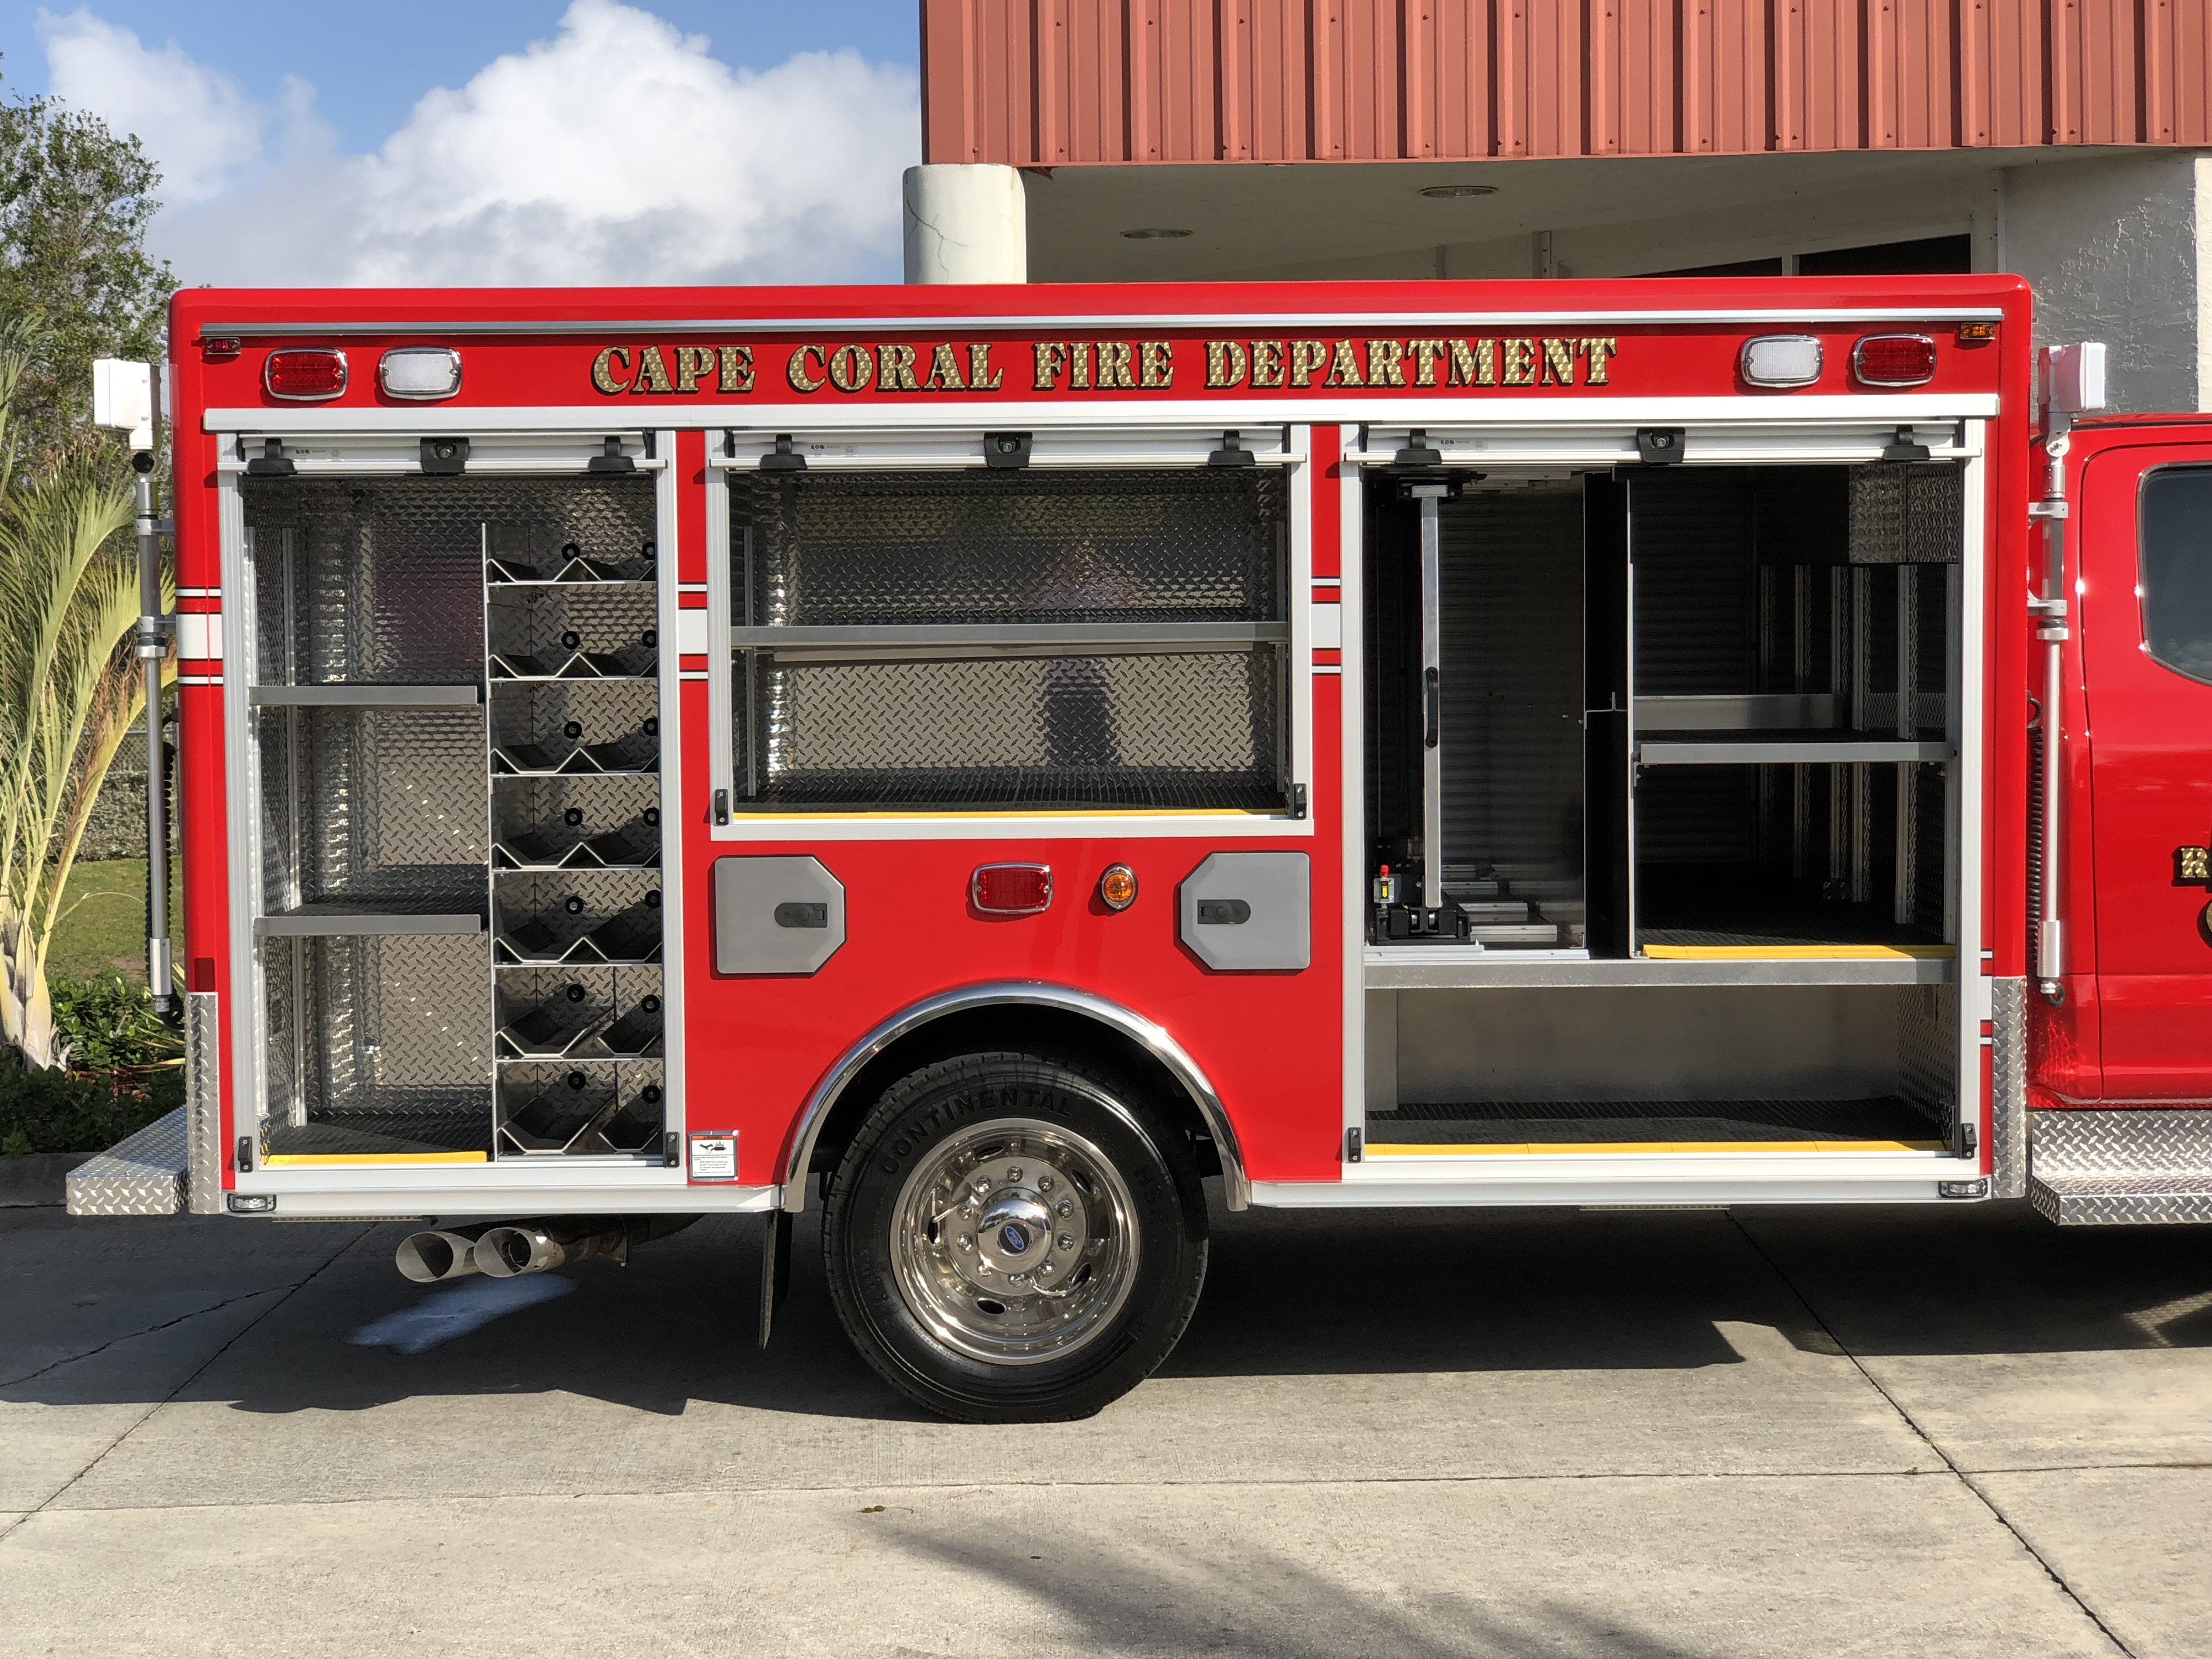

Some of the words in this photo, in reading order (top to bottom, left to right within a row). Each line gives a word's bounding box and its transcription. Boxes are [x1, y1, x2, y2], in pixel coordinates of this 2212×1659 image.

[590, 346, 756, 396] CAPE
[786, 342, 1004, 394] CORAL
[1031, 341, 1175, 391] FIRE
[1204, 337, 1617, 390] DEPARTMENT
[880, 1087, 1071, 1175] CONTINENTAL
